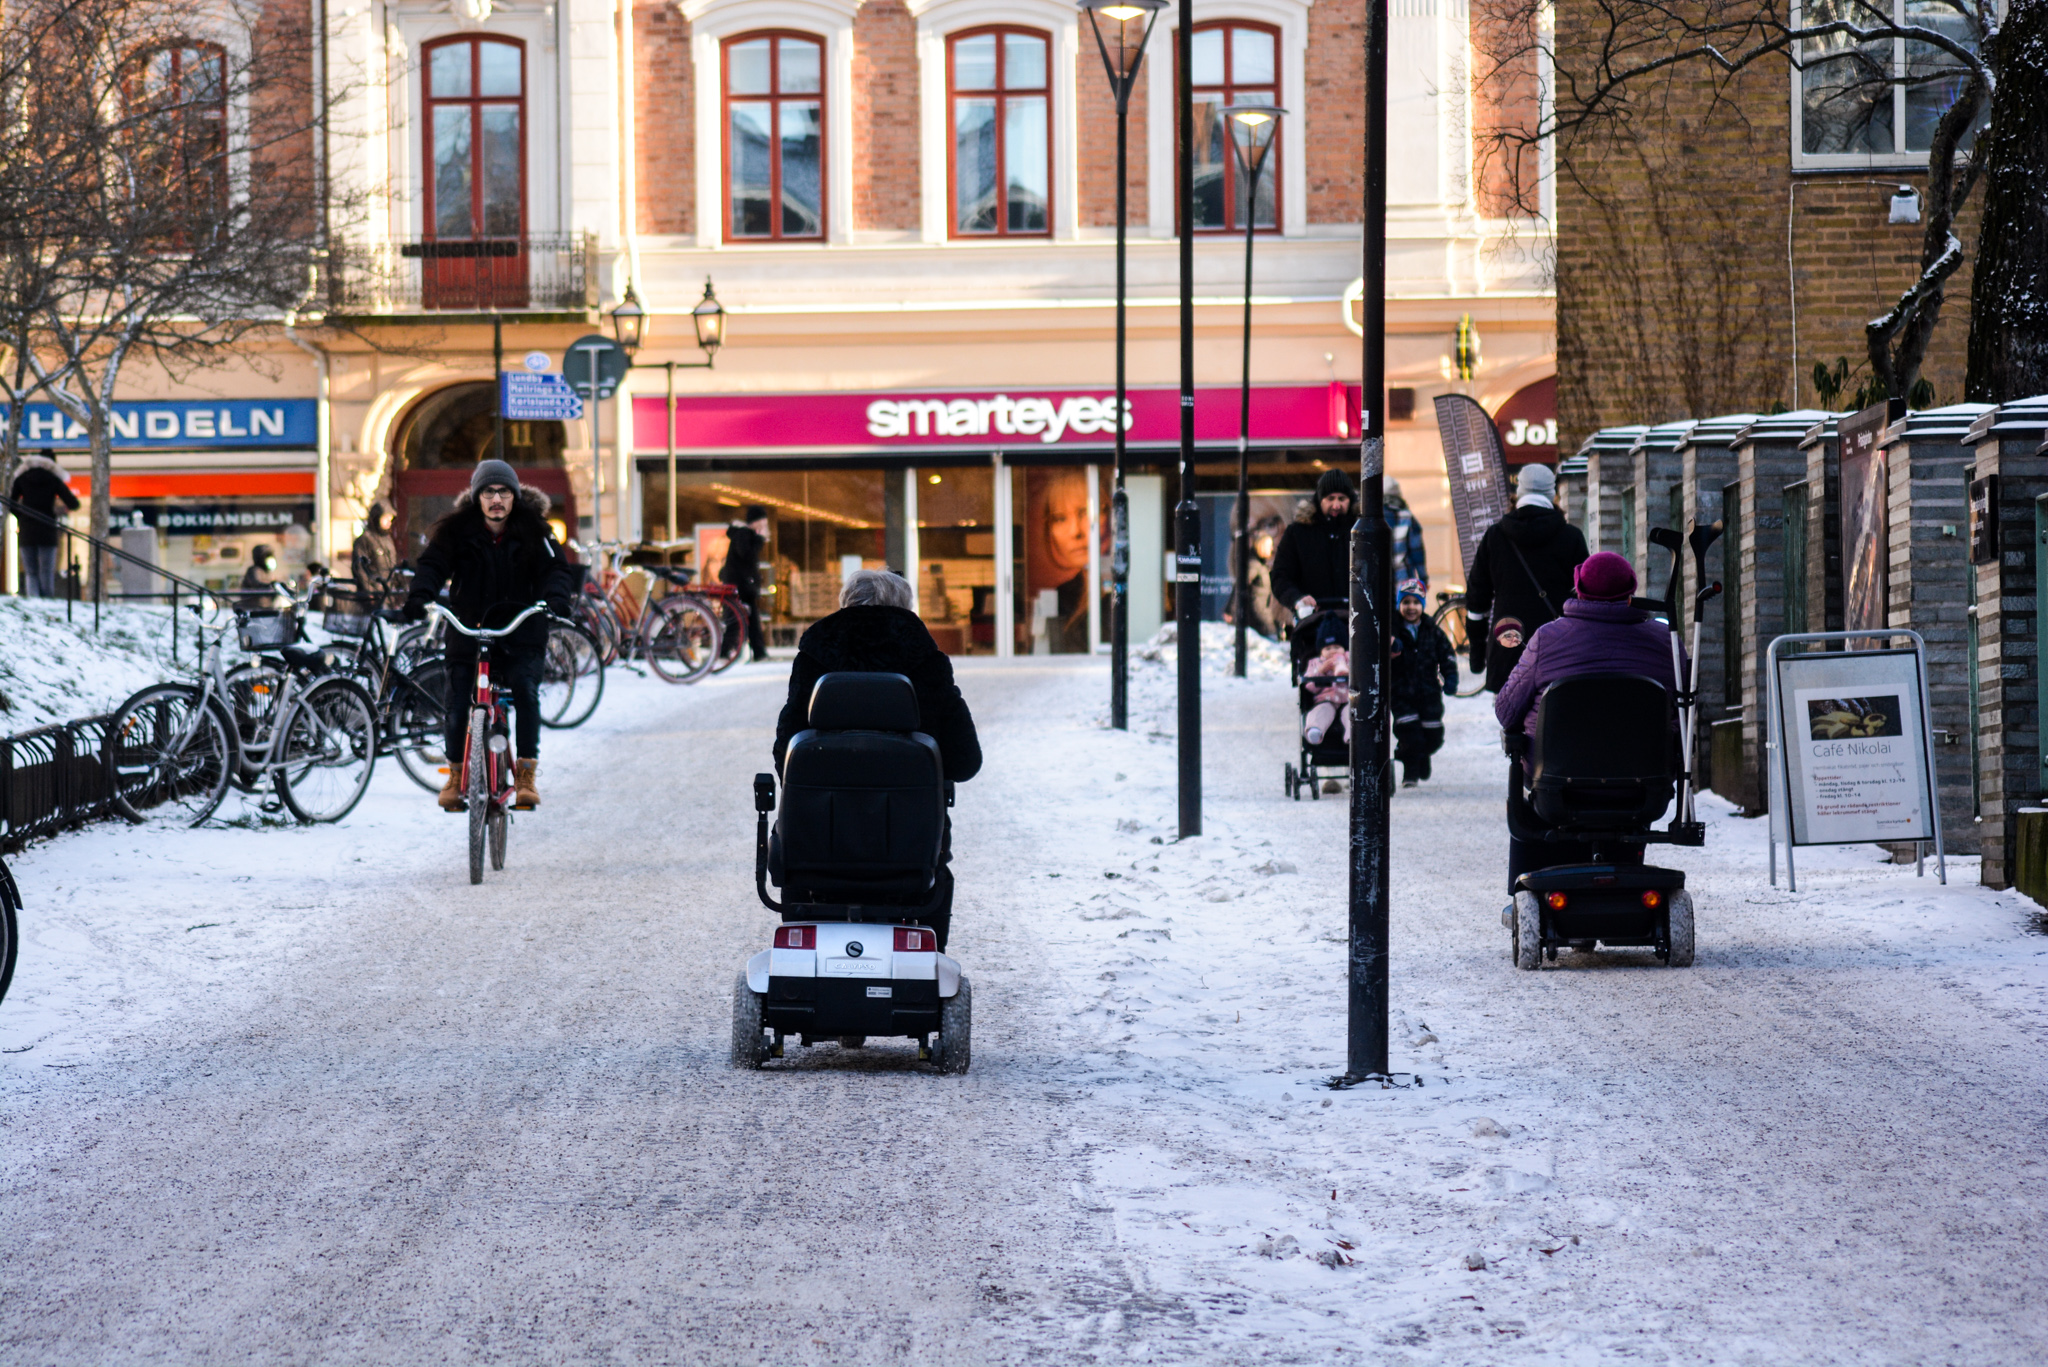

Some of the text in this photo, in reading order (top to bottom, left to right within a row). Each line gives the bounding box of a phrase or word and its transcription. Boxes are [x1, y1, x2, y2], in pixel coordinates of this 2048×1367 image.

[867, 394, 1133, 443] smarteyes
[511, 422, 533, 447] 11
[157, 512, 294, 528] BOKHANDELN
[1813, 741, 1892, 758] Café Nikolai
[834, 962, 876, 971] CALYPSO
